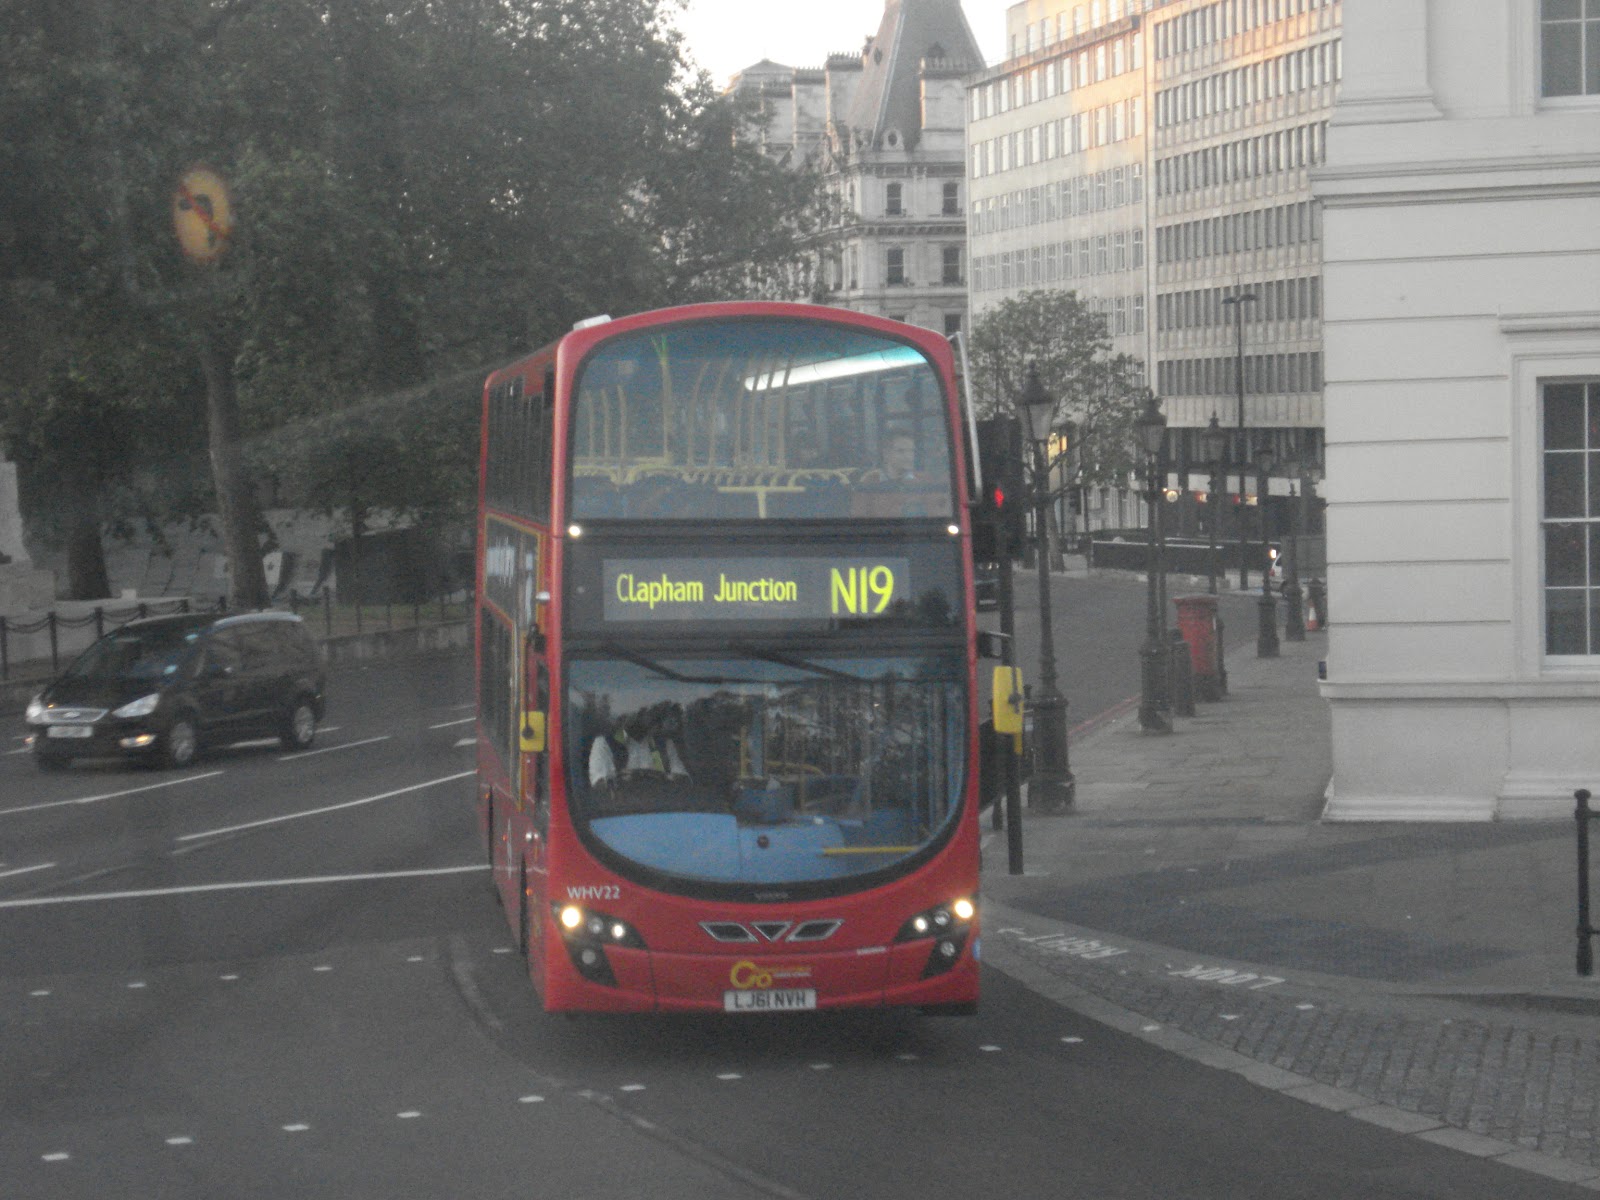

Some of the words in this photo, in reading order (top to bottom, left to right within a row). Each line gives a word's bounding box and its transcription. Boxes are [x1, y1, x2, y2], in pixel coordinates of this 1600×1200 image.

[616, 573, 704, 609] Clapham
[713, 572, 798, 602] Junction
[830, 565, 894, 614] N19
[566, 885, 621, 900] WHV22
